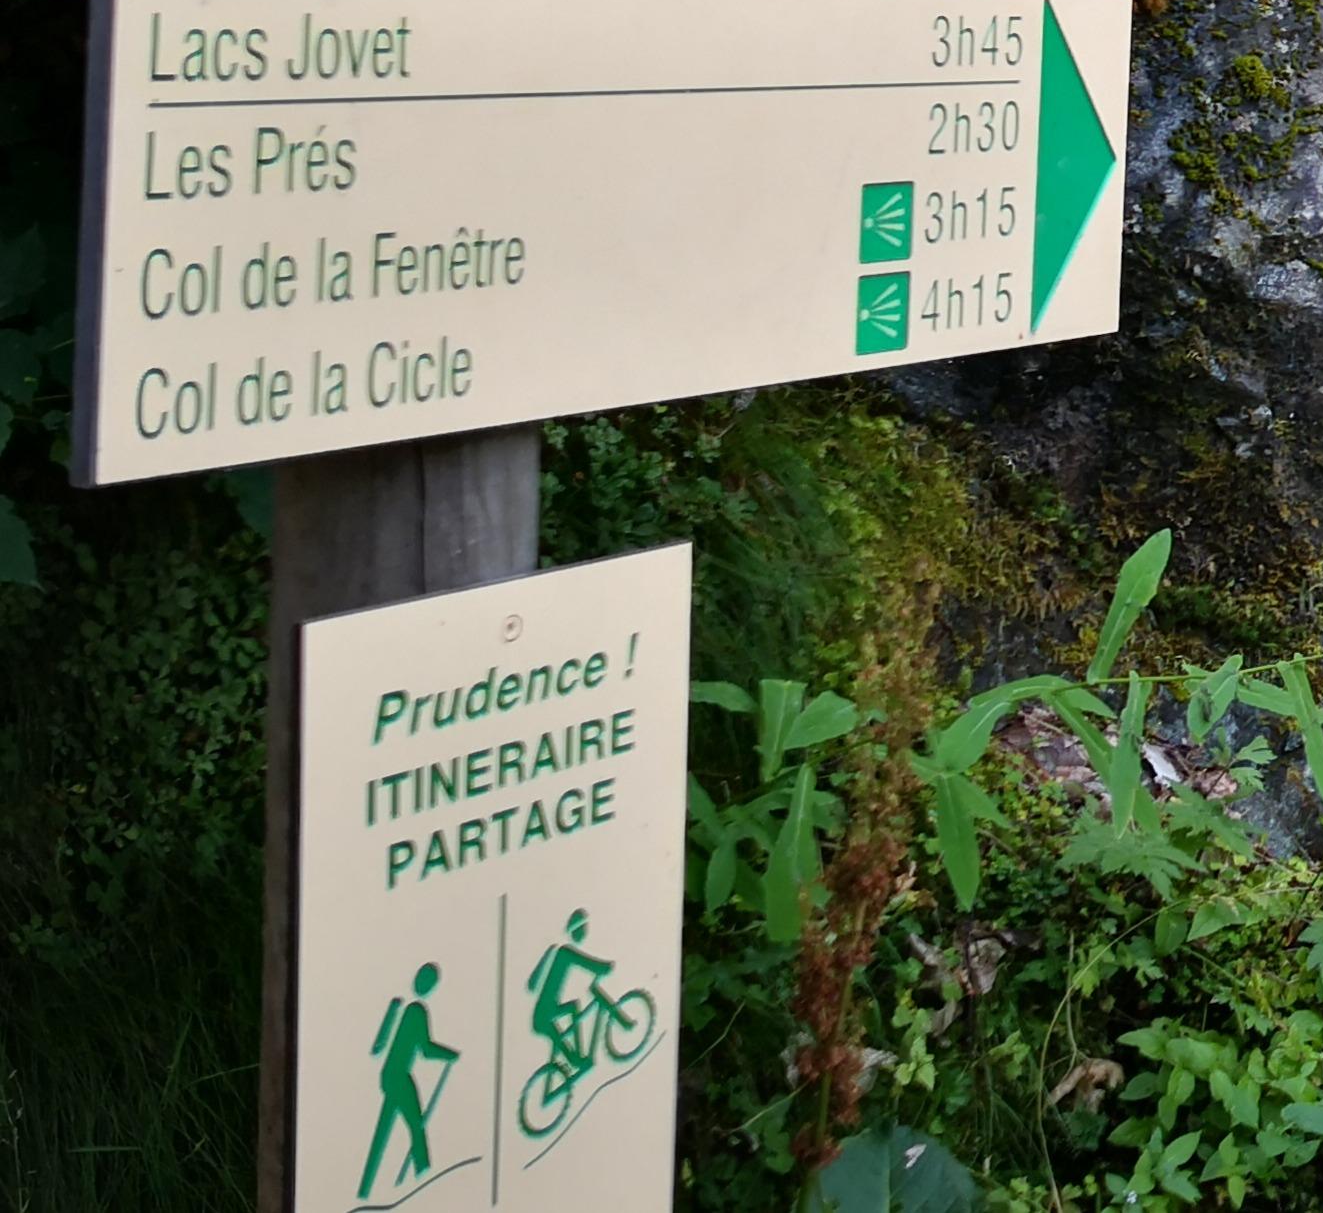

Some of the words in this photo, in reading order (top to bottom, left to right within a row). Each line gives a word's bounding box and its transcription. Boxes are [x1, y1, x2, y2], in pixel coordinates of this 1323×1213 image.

[150, 11, 270, 83] Lacs
[286, 11, 413, 81] Jovet
[931, 15, 1024, 68] 3h45
[143, 130, 235, 201] Les
[253, 123, 358, 195] Prés
[928, 100, 1020, 156] 2h30
[924, 186, 1017, 244] 3h15
[140, 245, 223, 321] Col
[241, 241, 299, 311] de
[316, 236, 355, 304] la
[370, 226, 527, 299] Fenêtre
[920, 271, 1013, 332] 4h15
[135, 361, 218, 440] Col
[236, 356, 294, 427] de
[311, 350, 350, 417] la
[367, 335, 474, 409] Cicle
[371, 648, 609, 747] Prudence
[624, 632, 641, 677] !
[364, 708, 637, 828] ITINERAIRE
[386, 778, 617, 890] PARTAGE
